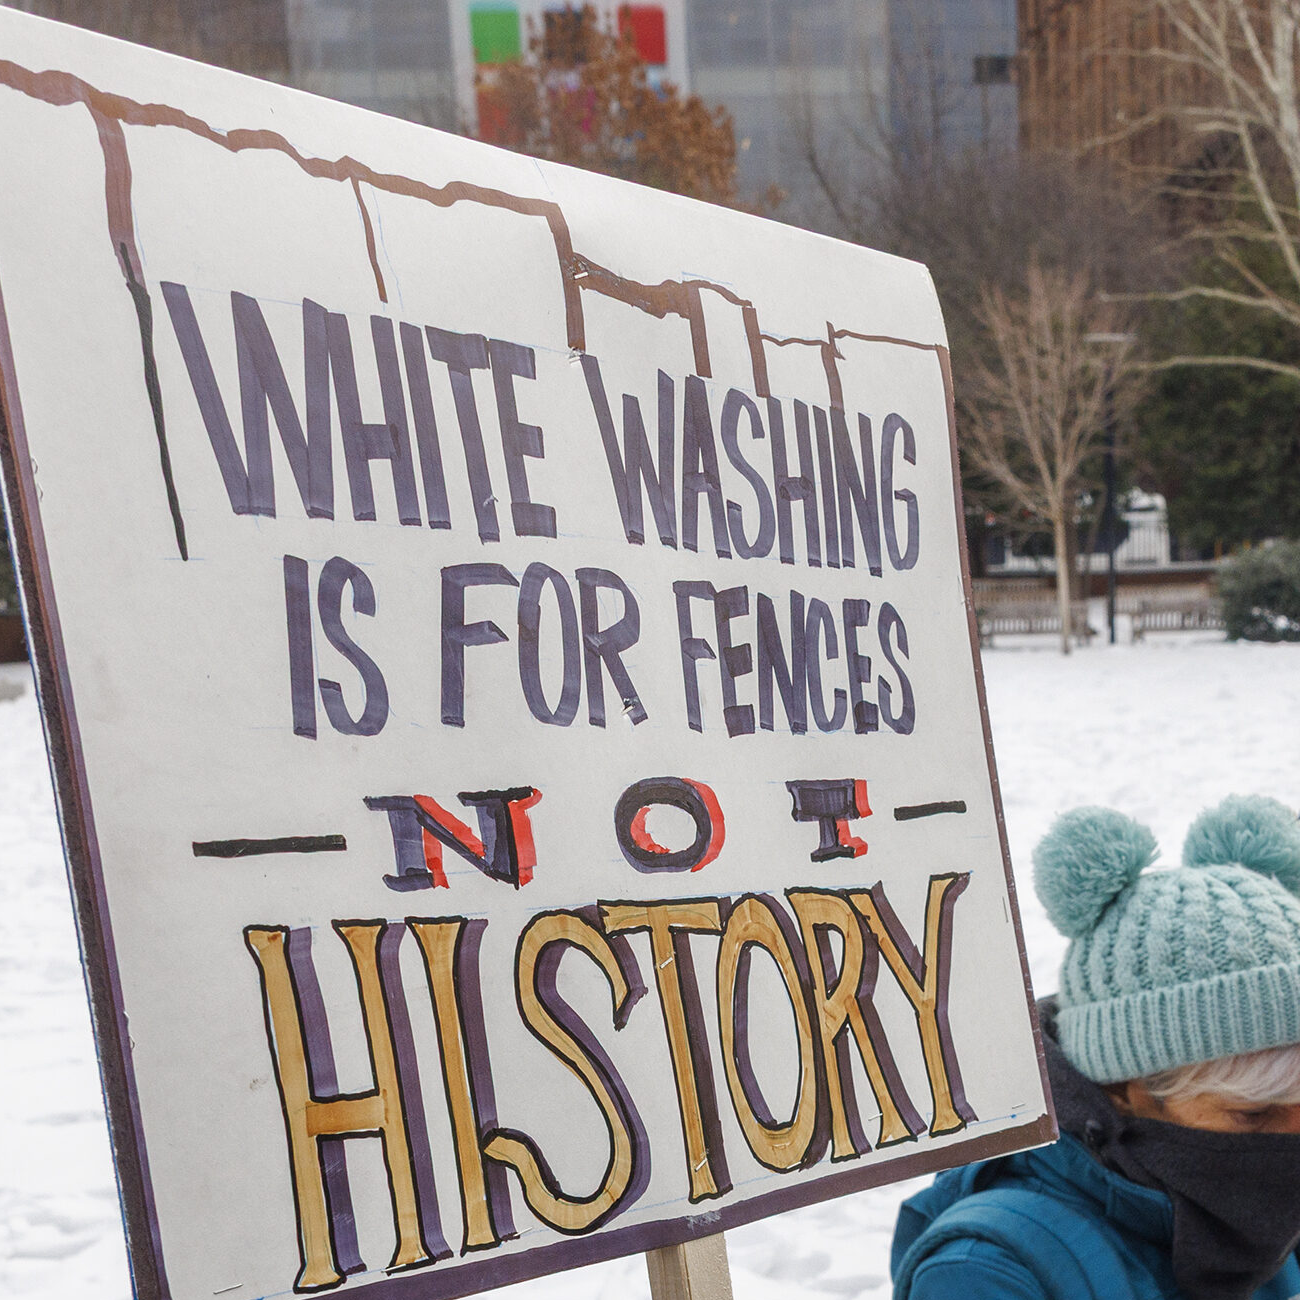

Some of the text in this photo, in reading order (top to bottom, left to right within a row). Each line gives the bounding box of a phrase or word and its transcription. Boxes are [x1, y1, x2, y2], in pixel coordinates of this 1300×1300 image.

[160, 281, 920, 577] WHITE WASHING
[284, 554, 916, 741] IS FOR FENCES
[243, 870, 978, 1293] HISTORY
